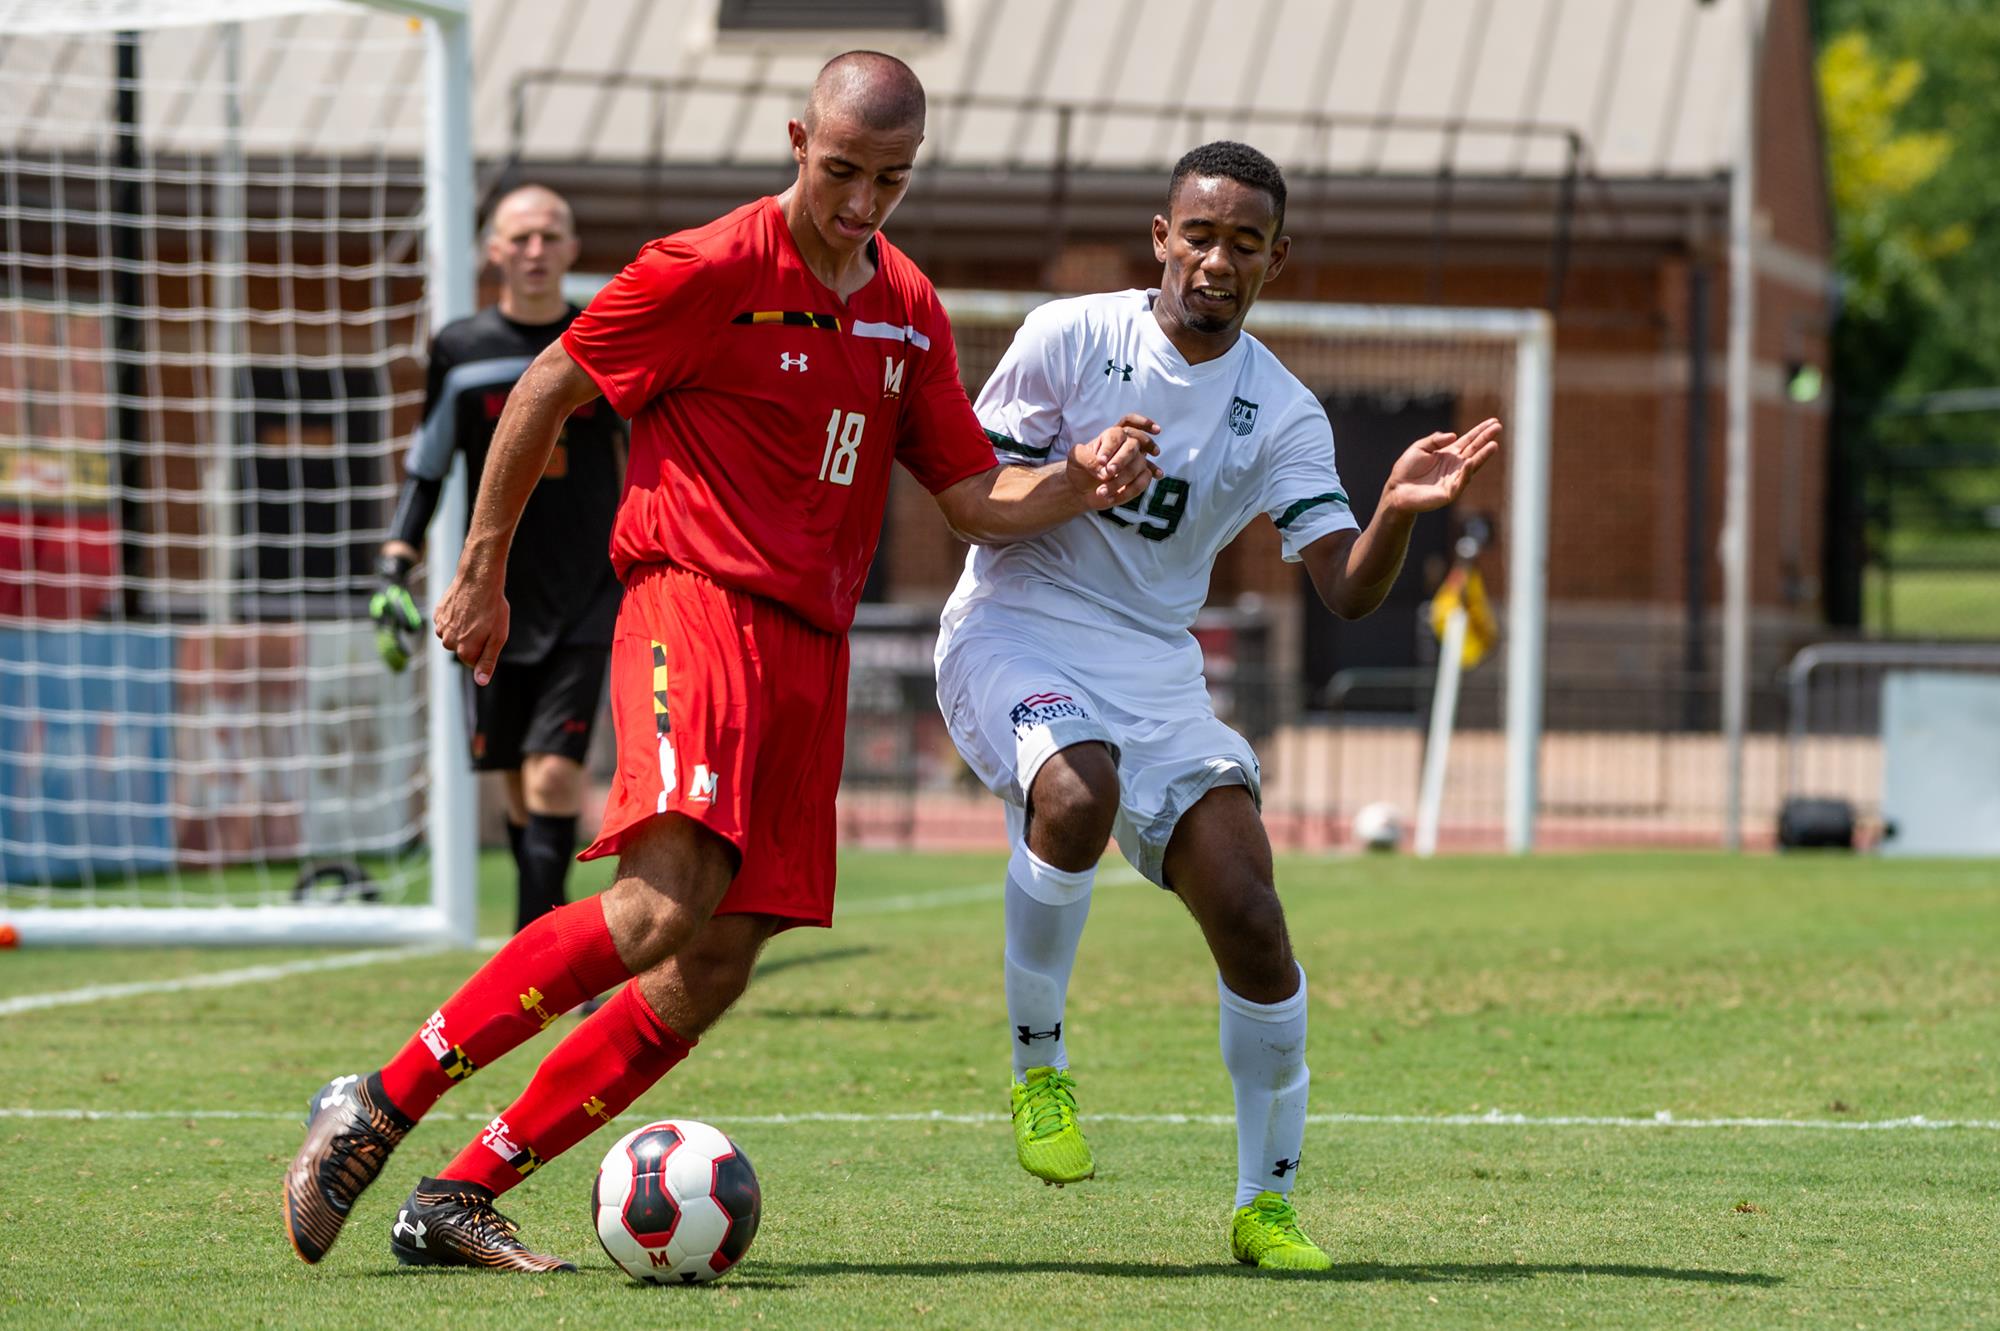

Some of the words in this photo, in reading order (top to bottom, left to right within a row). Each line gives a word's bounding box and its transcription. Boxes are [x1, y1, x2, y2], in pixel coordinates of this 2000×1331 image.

[884, 356, 904, 393] M
[818, 408, 866, 486] 18
[688, 764, 719, 805] M
[648, 1250, 672, 1268] M
